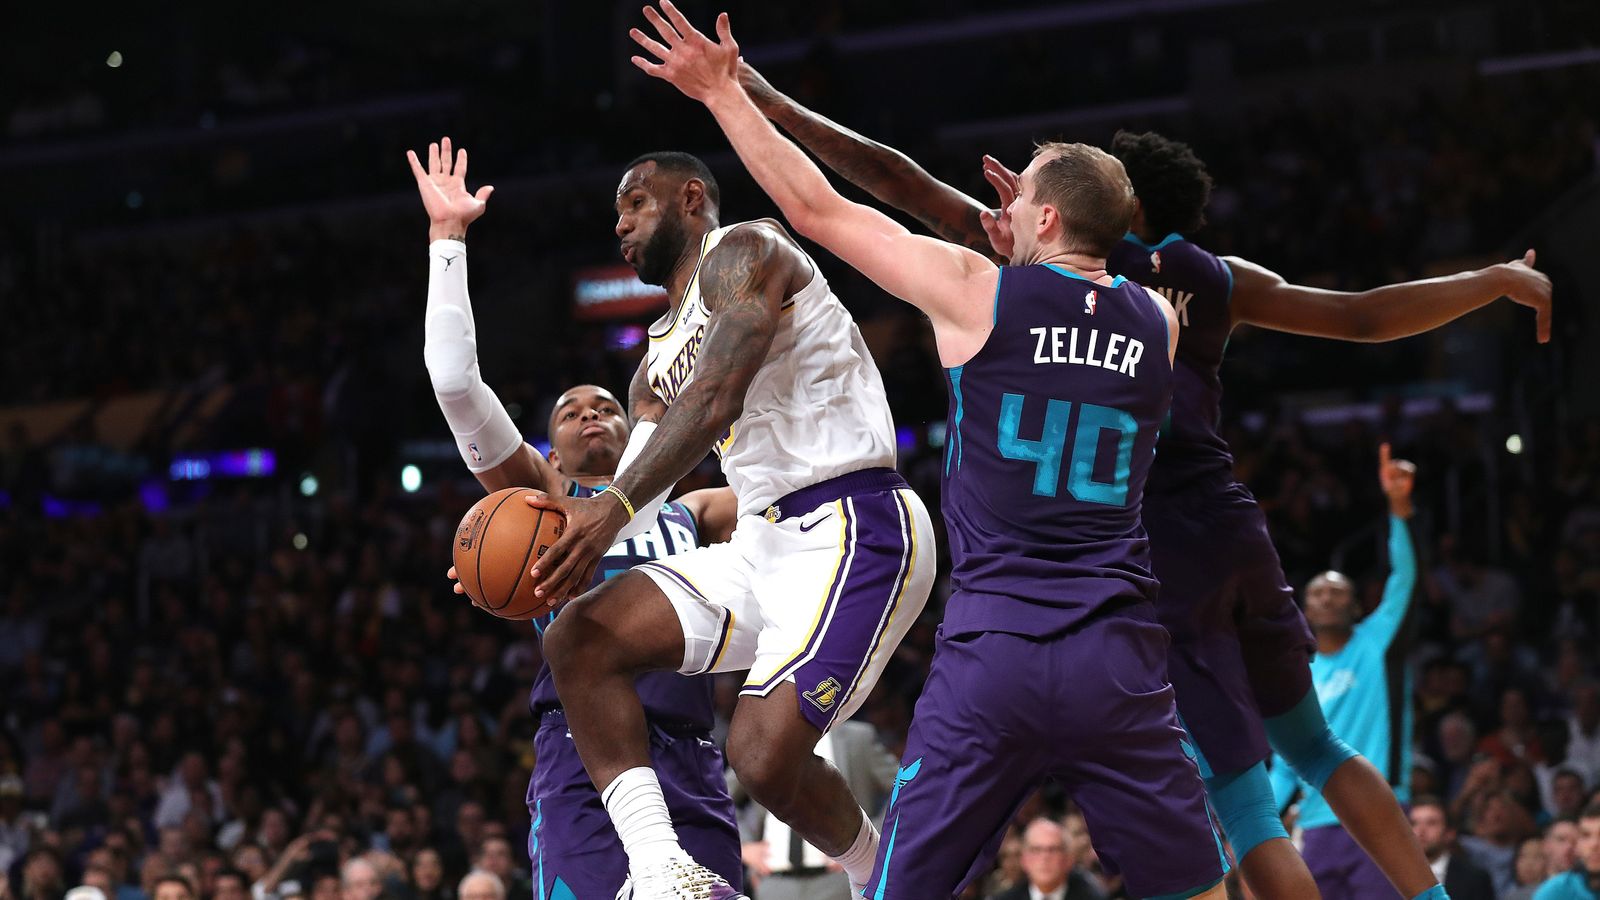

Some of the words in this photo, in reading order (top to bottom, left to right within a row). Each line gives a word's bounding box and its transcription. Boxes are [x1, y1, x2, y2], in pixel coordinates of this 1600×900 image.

[651, 325, 705, 403] AKERS
[1030, 327, 1144, 378] ZELLER
[998, 393, 1138, 506] 40
